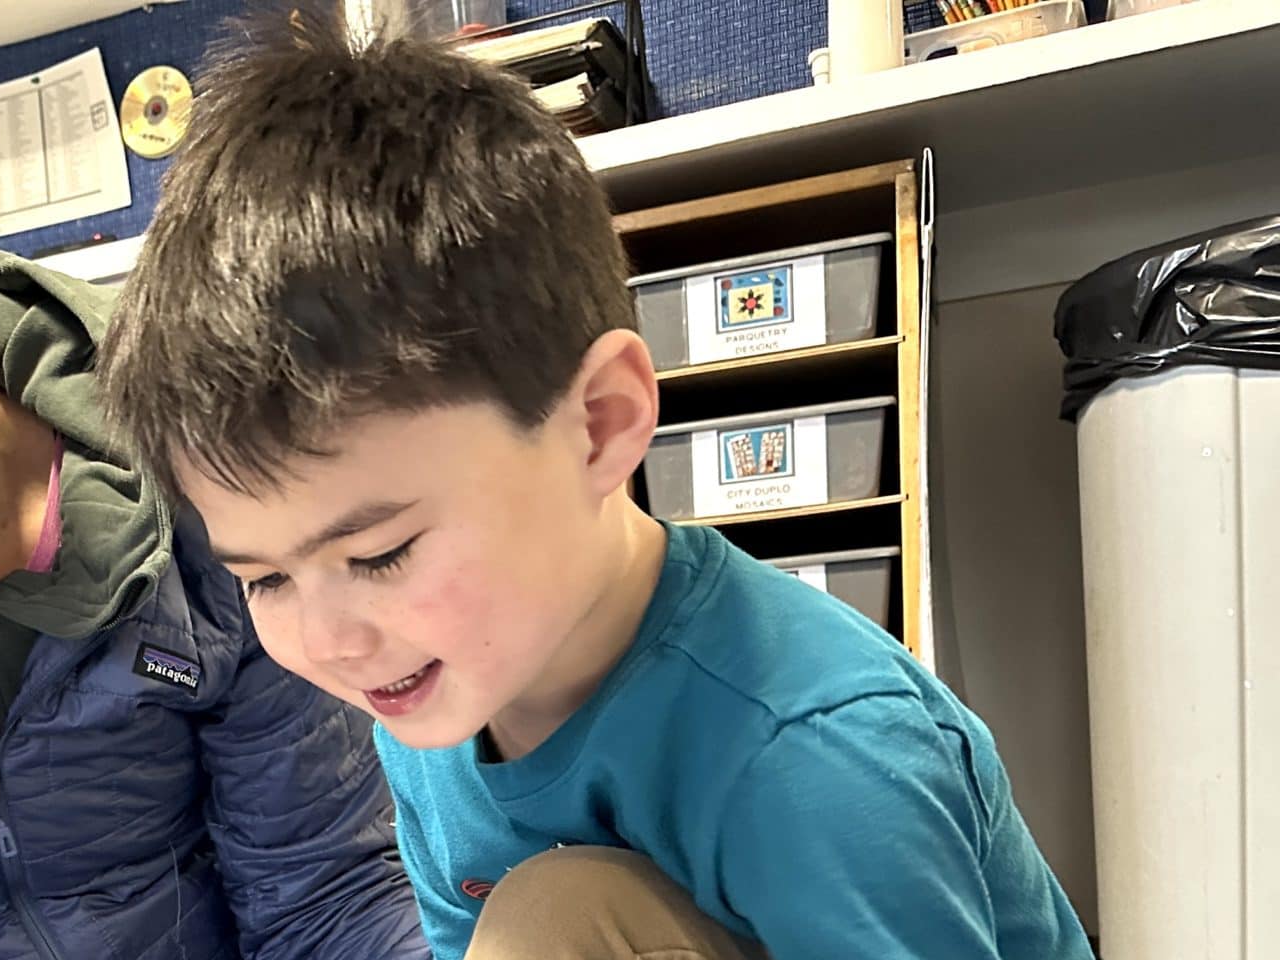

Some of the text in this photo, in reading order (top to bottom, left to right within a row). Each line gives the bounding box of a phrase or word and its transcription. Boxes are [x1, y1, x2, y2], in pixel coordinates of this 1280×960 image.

[726, 328, 787, 342] PARQUETRY
[735, 341, 779, 354] DESIGNS
[727, 484, 791, 499] CITY DUPLO
